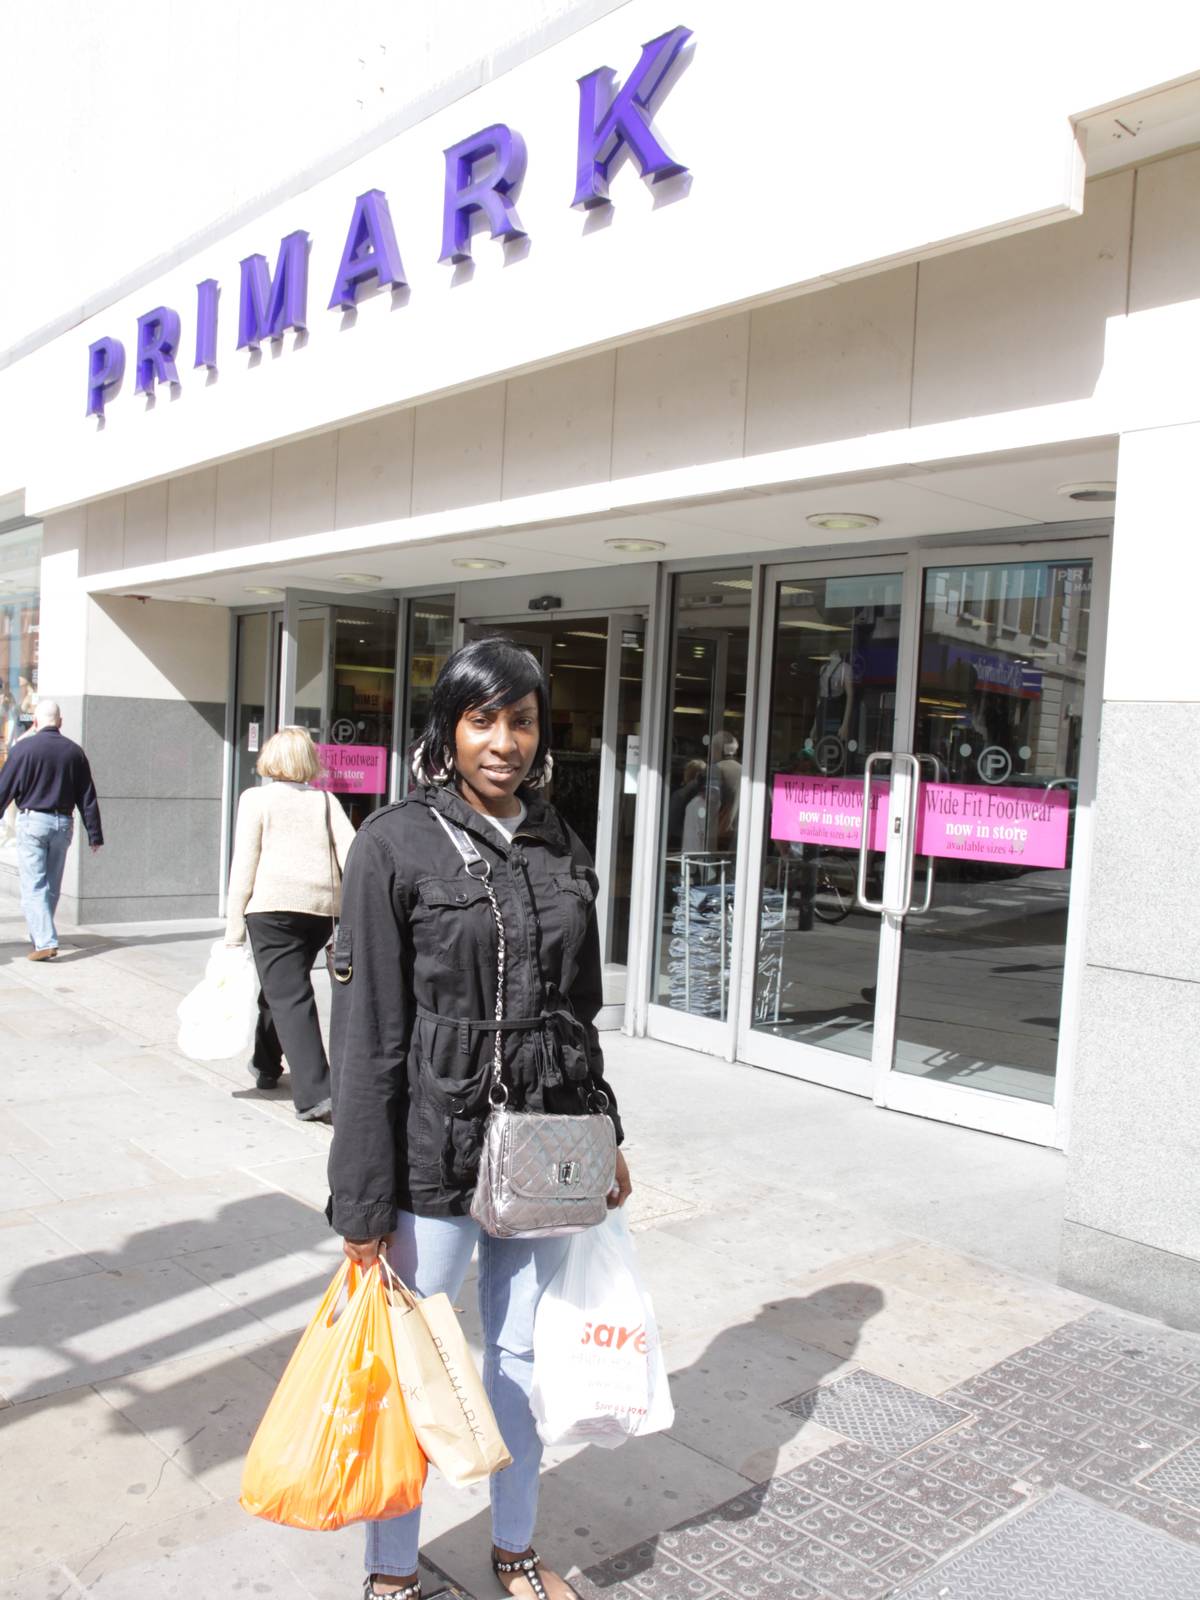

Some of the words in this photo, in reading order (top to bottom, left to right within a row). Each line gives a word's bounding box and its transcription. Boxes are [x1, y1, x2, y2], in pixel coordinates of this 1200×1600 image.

[86, 25, 694, 418] PRIMARK
[340, 750, 379, 767] Footwear
[784, 781, 809, 804] Wide
[812, 783, 828, 806] Fit
[925, 789, 959, 815] Wide
[962, 791, 983, 817] Fit
[987, 793, 1056, 822] Footwear
[800, 811, 819, 824] now
[822, 809, 832, 825] in
[834, 812, 861, 828] store
[945, 822, 973, 836] now
[976, 820, 990, 838] in
[992, 825, 1028, 841] store
[946, 840, 985, 853] available
[986, 843, 1006, 855] sizes
